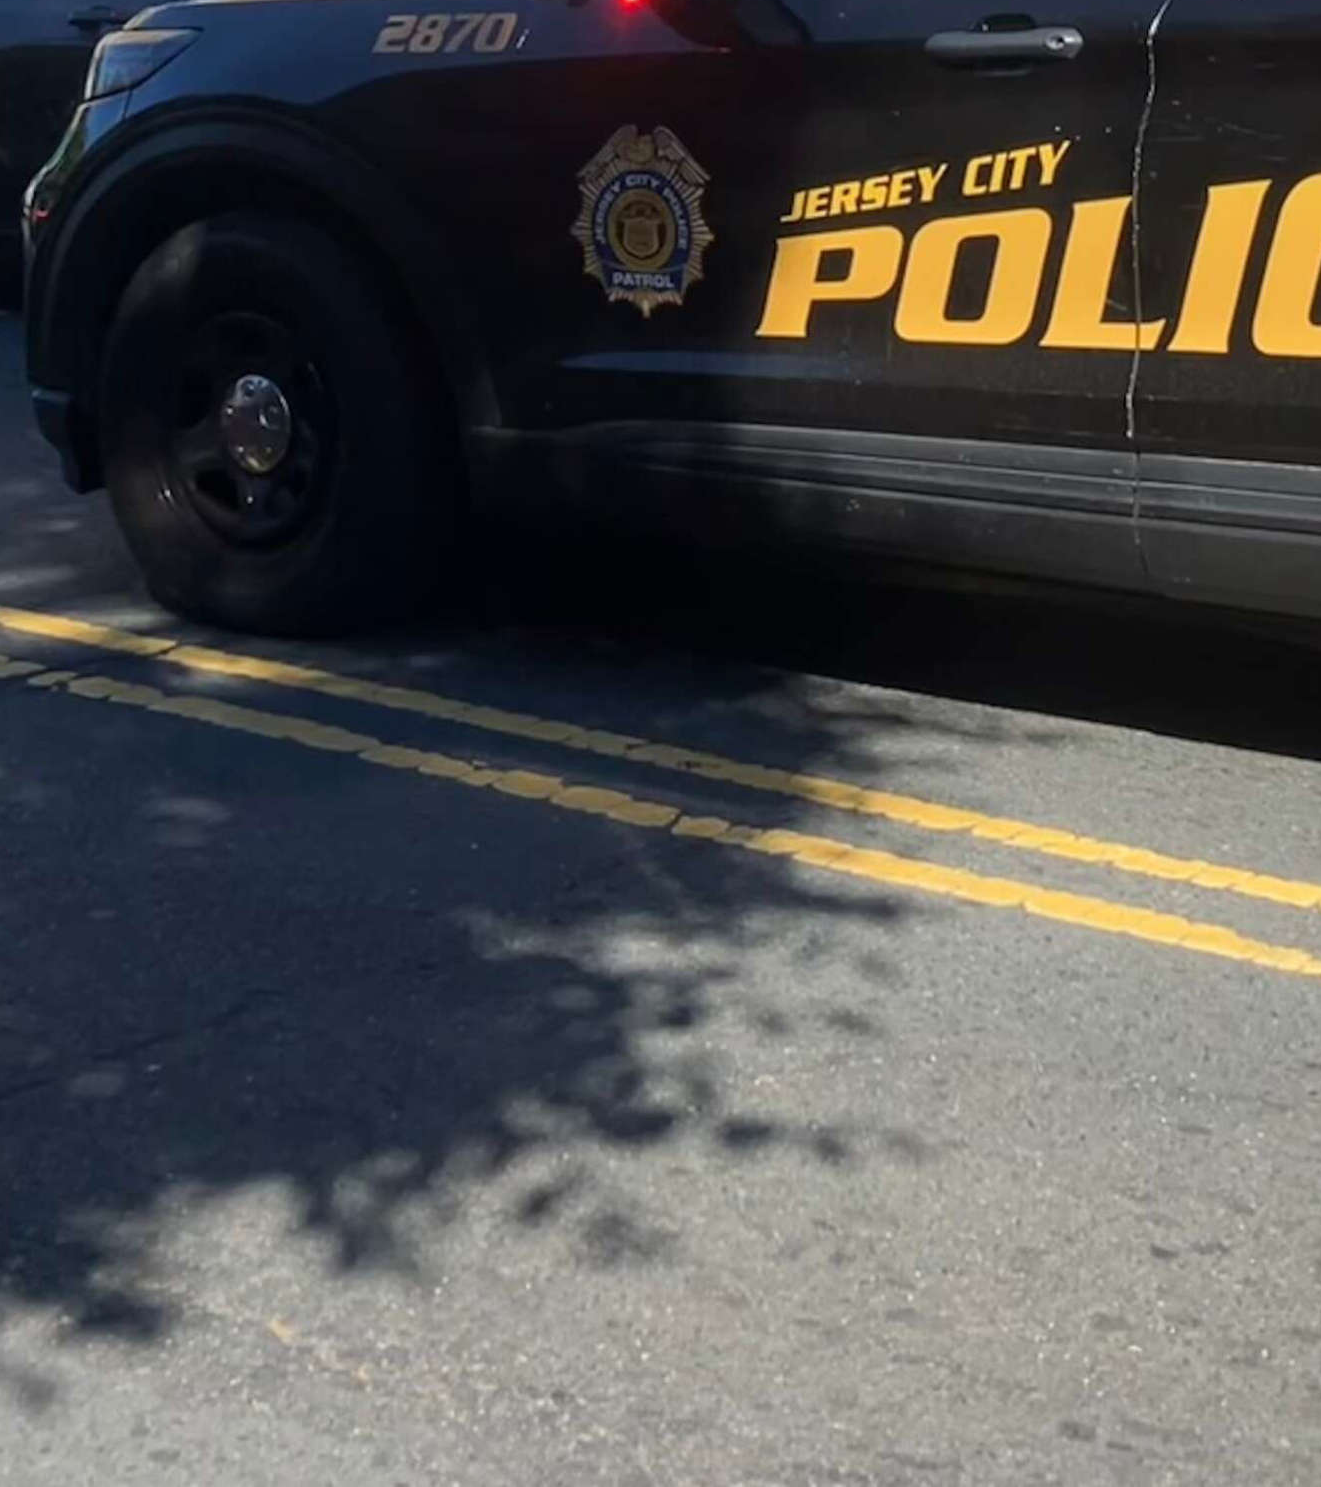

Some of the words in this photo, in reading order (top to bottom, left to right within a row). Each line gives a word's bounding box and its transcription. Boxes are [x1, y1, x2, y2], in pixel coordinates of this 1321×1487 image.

[372, 12, 519, 54] 2870
[625, 173, 660, 189] CITY
[780, 162, 949, 222] JERSEY
[961, 139, 1071, 197] CITY
[612, 271, 675, 289] PATROL
